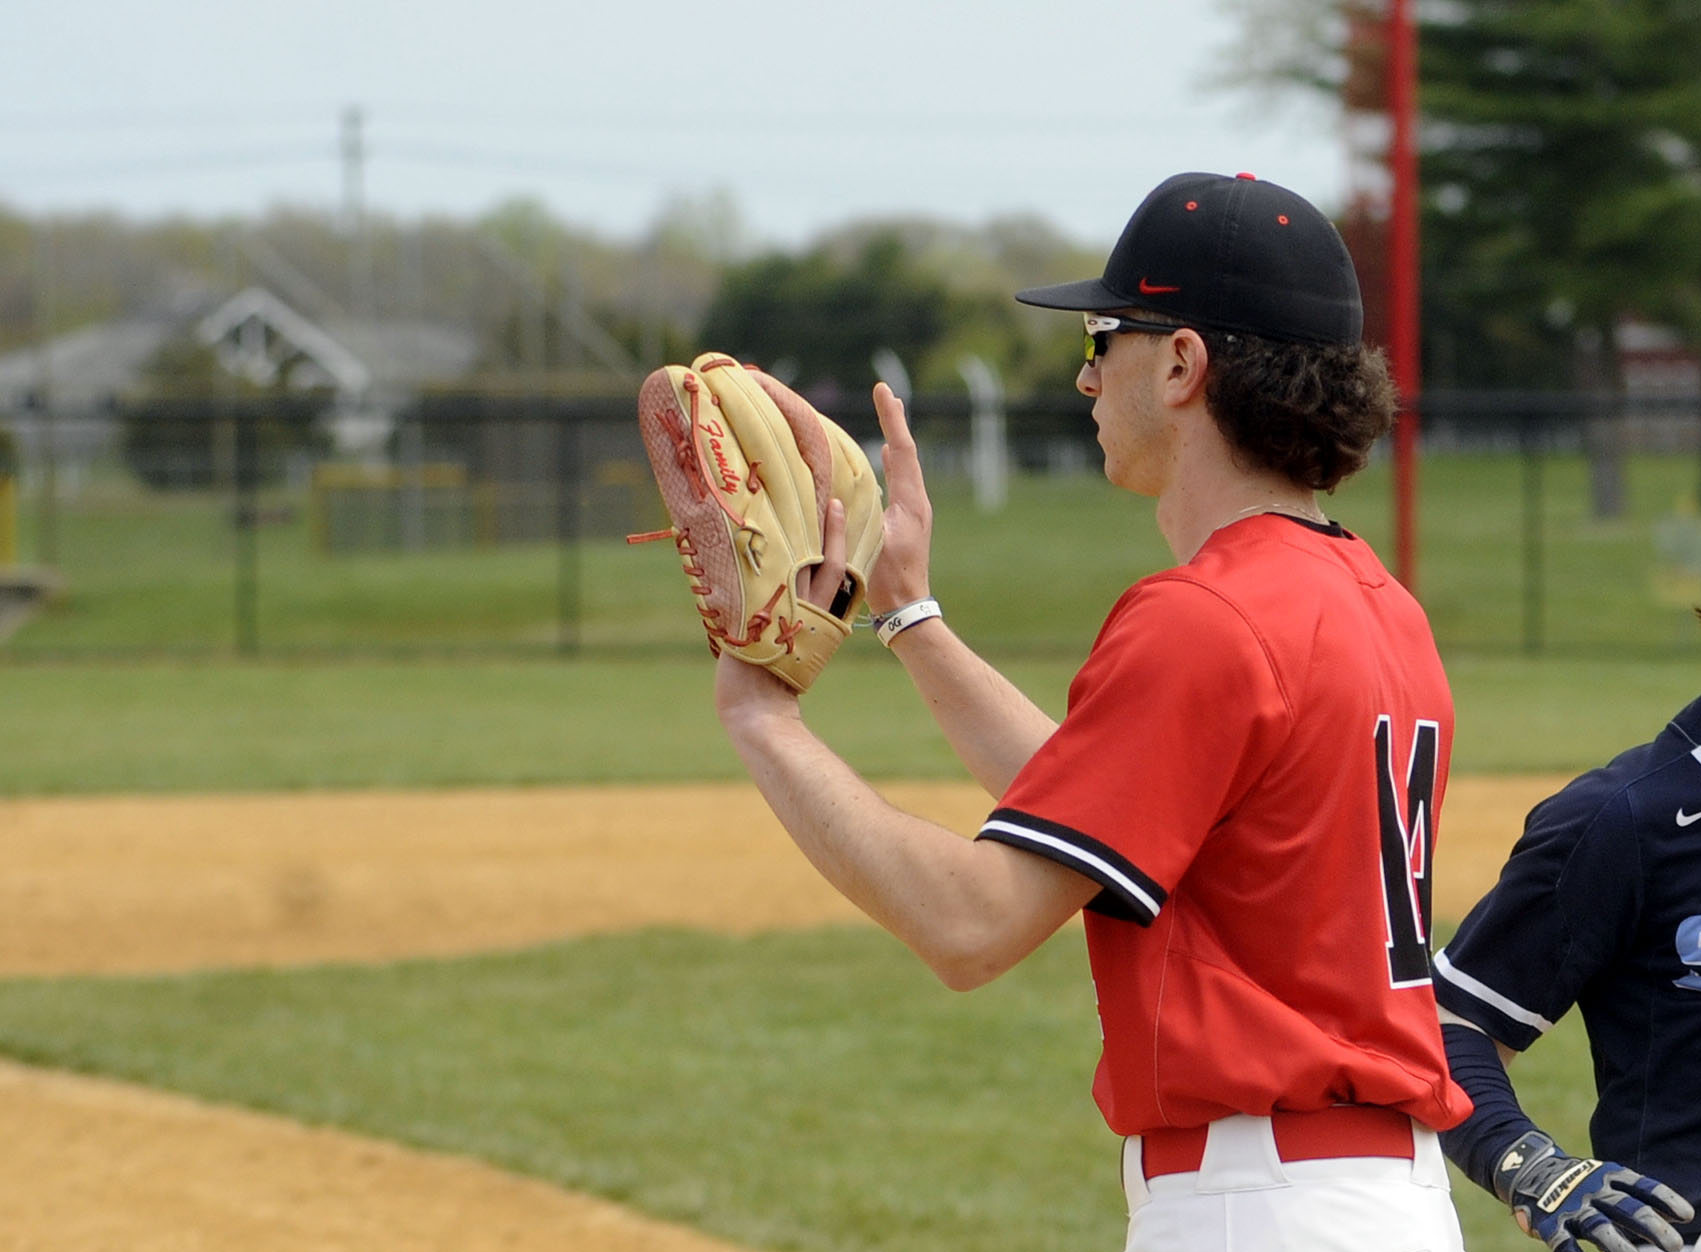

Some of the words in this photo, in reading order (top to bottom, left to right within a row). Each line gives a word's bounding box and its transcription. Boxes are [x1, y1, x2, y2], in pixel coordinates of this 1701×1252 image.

[699, 419, 741, 495] Family
[1373, 714, 1440, 990] 14
[1542, 1160, 1595, 1208] Franklin
